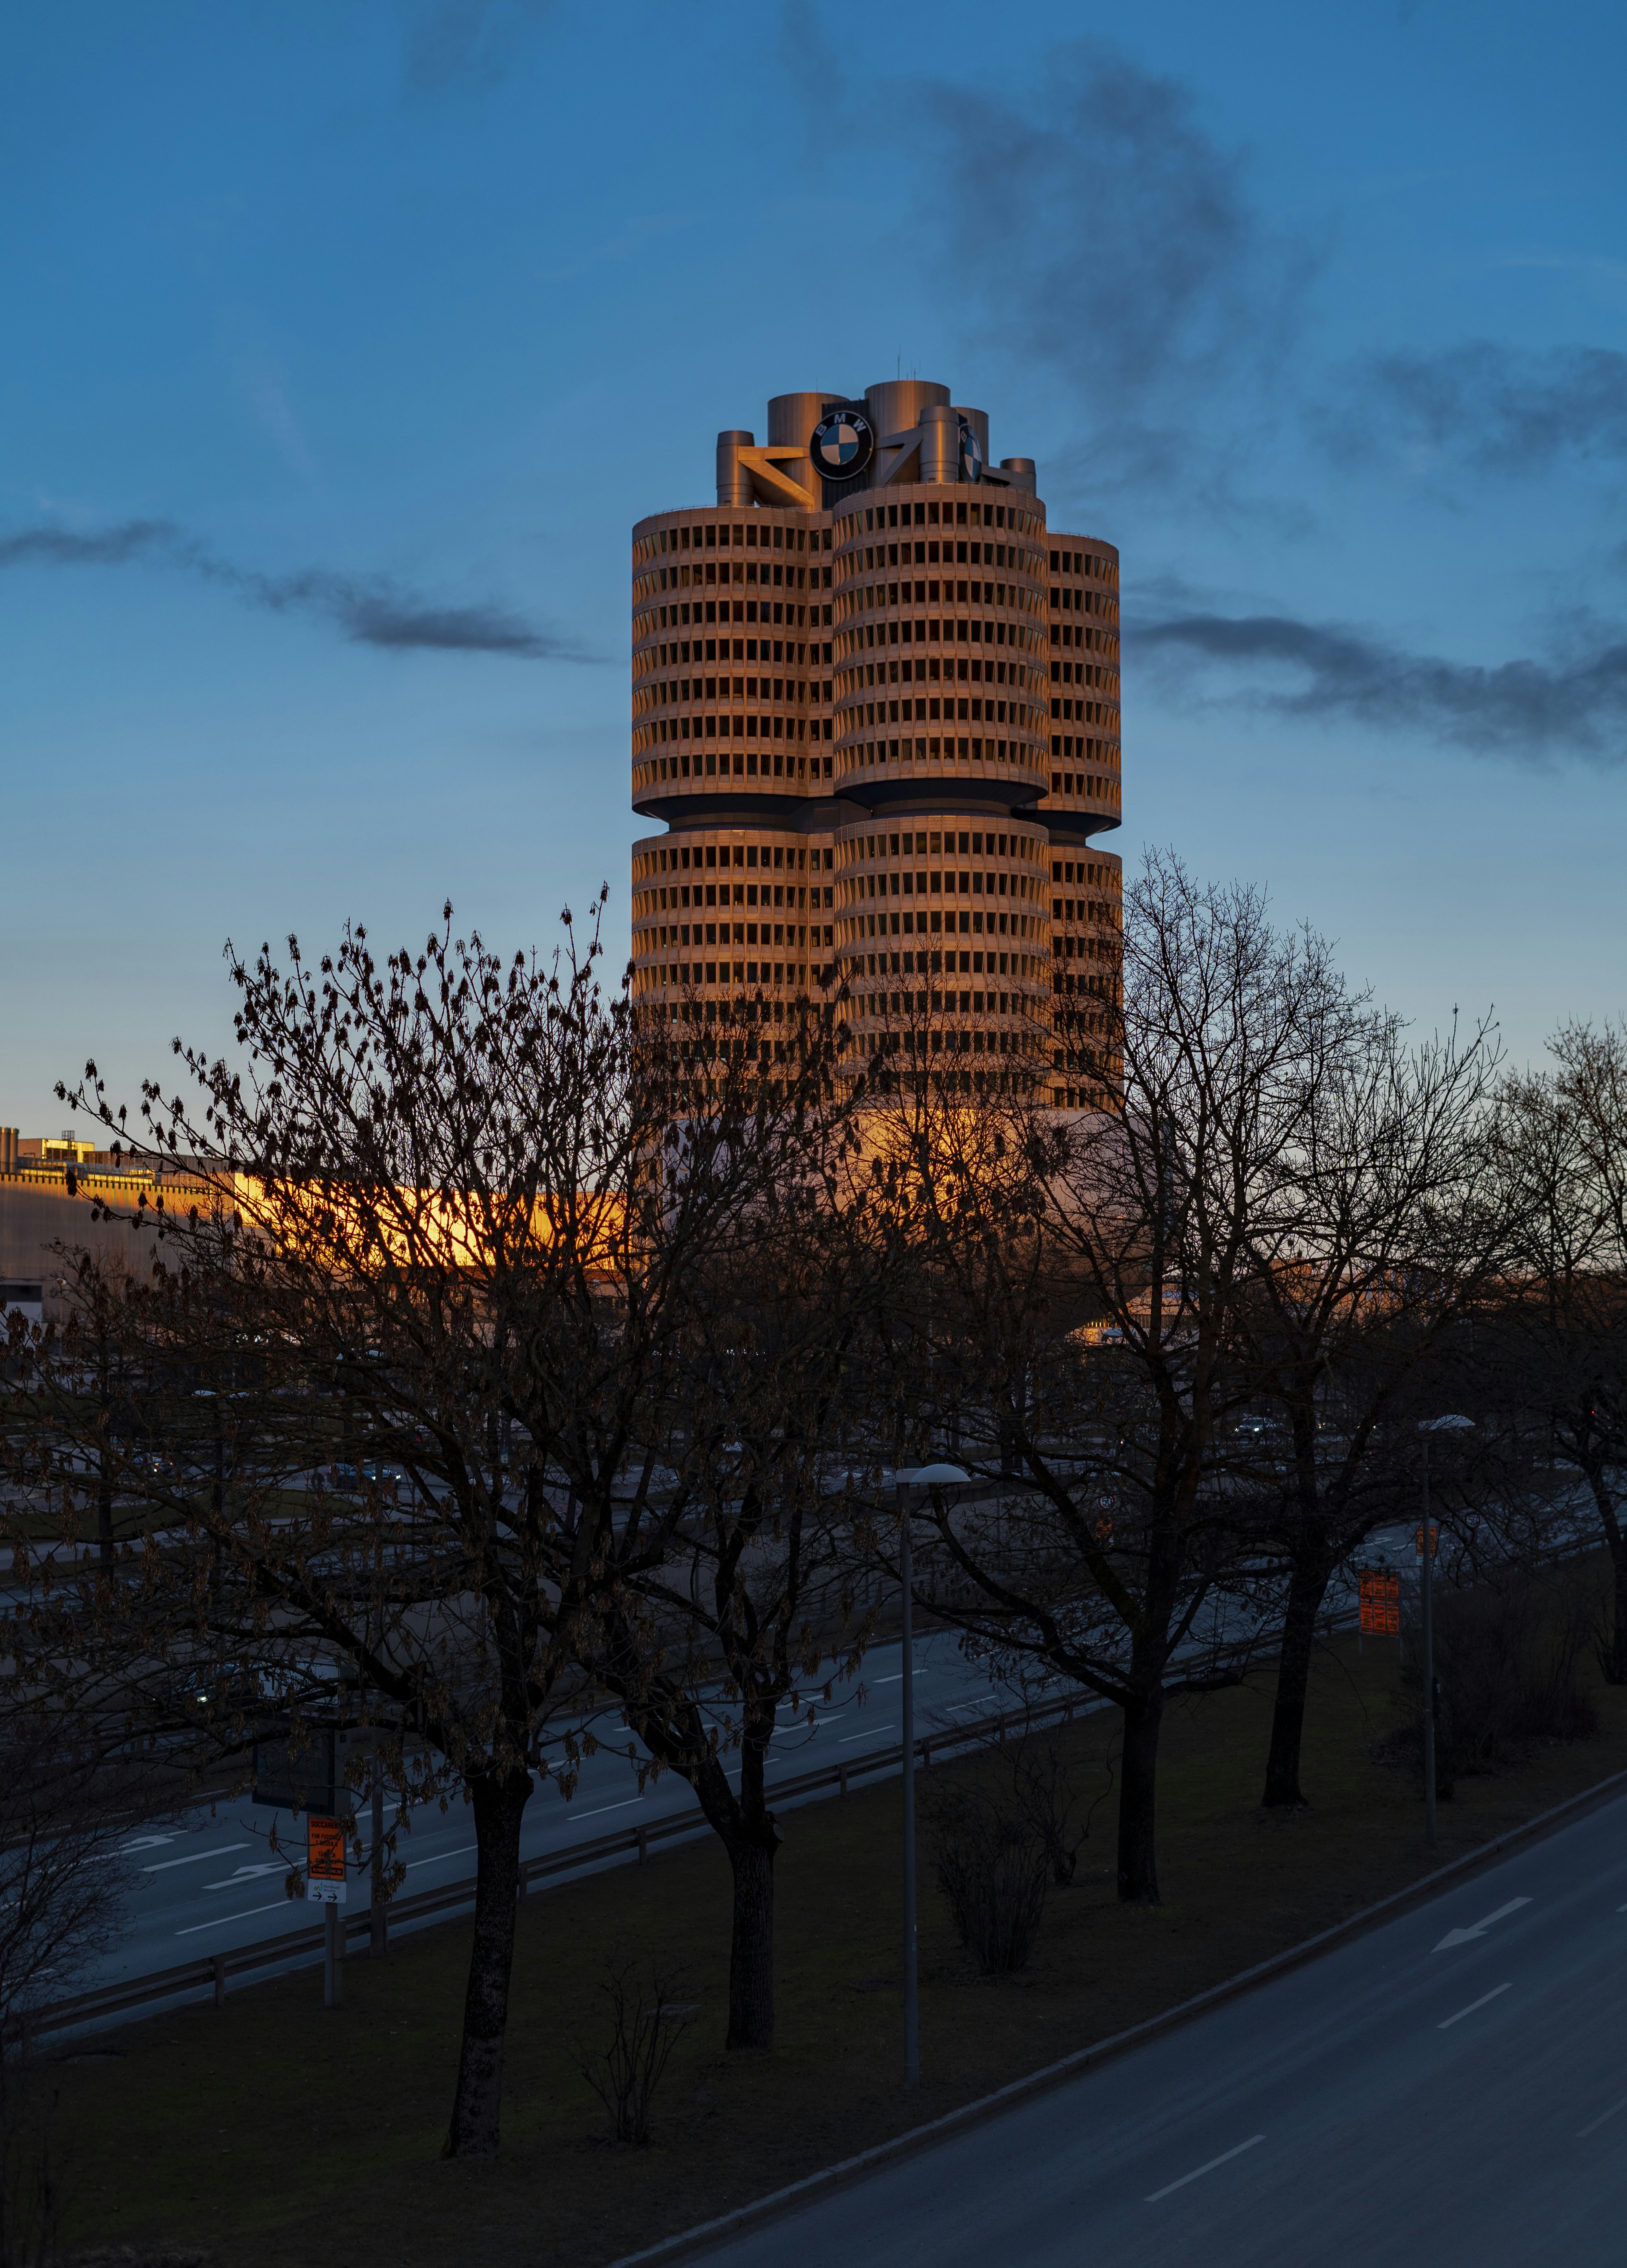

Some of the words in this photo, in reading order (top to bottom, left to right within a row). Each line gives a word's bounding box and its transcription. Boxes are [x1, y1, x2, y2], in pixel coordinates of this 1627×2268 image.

[815, 413, 866, 437] BMW
[1102, 1497, 1112, 1506] 50
[1468, 1515, 1478, 1525] 50
[311, 1821, 341, 1830] SOCCAREN
